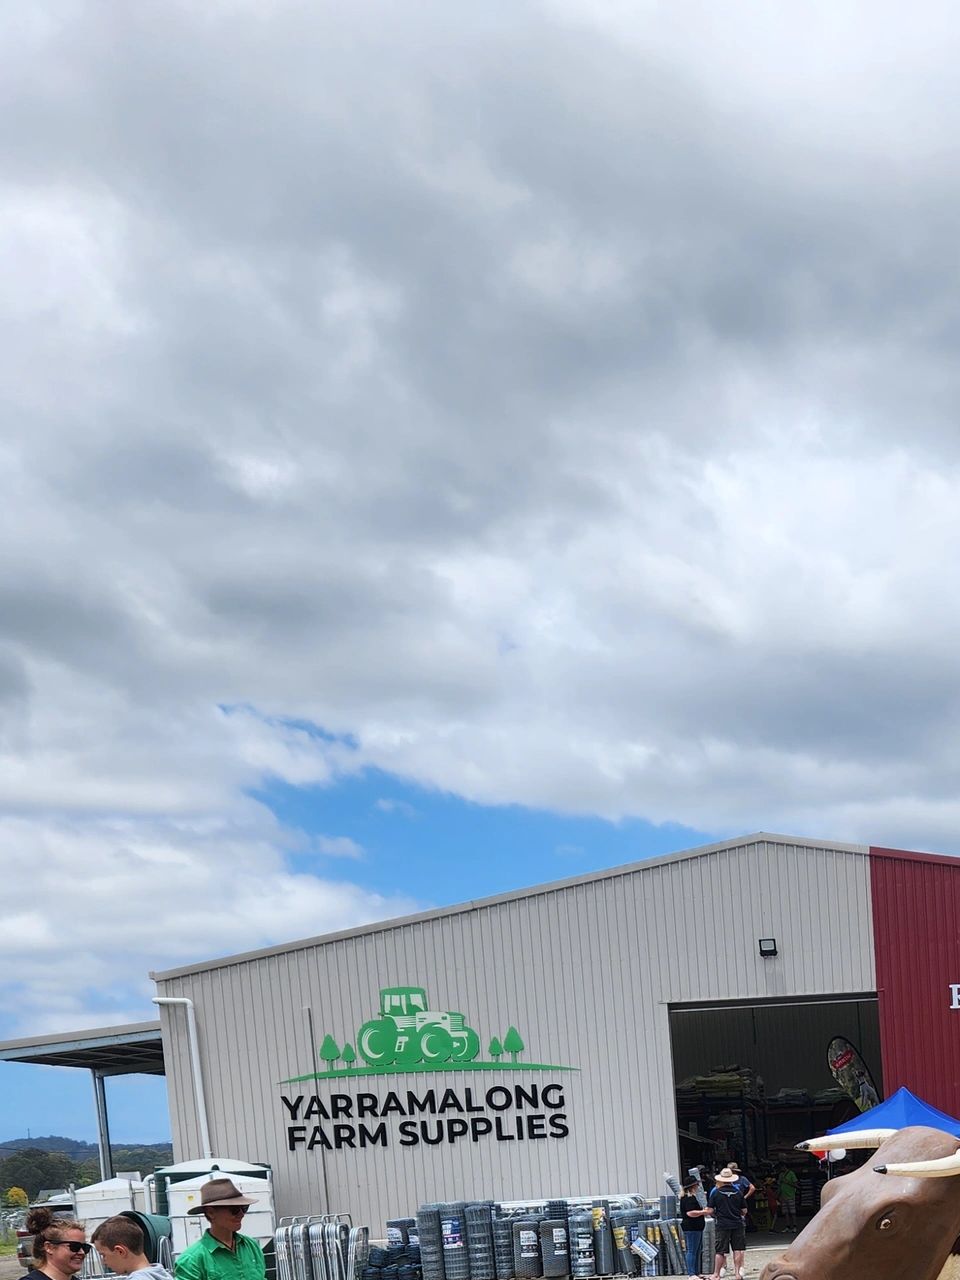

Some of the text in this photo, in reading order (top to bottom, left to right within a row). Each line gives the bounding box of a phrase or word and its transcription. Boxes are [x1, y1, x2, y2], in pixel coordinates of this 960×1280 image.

[280, 1083, 566, 1121] YARRAMALONG
[287, 1113, 570, 1151] FARM SUPPLIES
